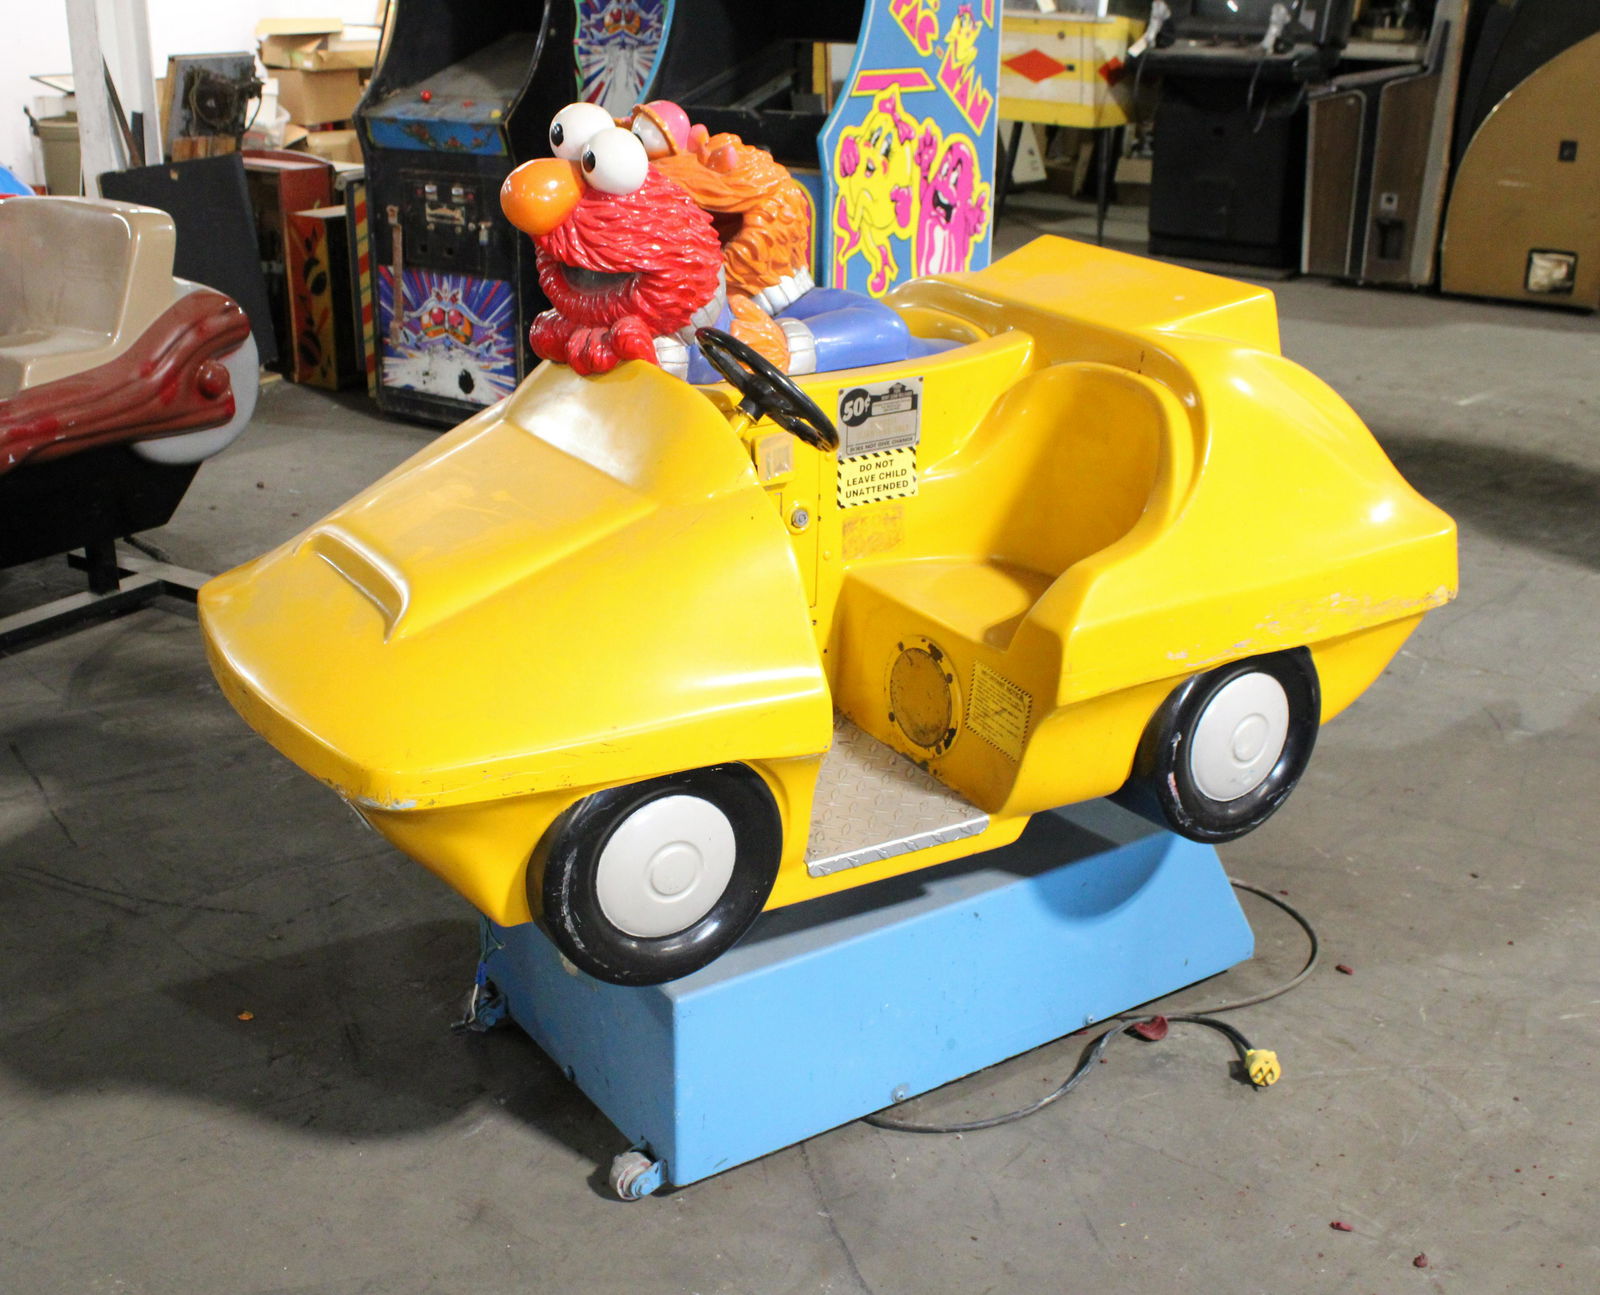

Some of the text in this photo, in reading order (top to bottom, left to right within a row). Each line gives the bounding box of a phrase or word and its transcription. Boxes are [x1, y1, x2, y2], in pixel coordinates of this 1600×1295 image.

[842, 395, 871, 422] 50¢
[859, 459, 894, 472] DO NOT
[847, 468, 907, 487] LEAVE CHILD
[845, 480, 909, 498] UNATTENDED
